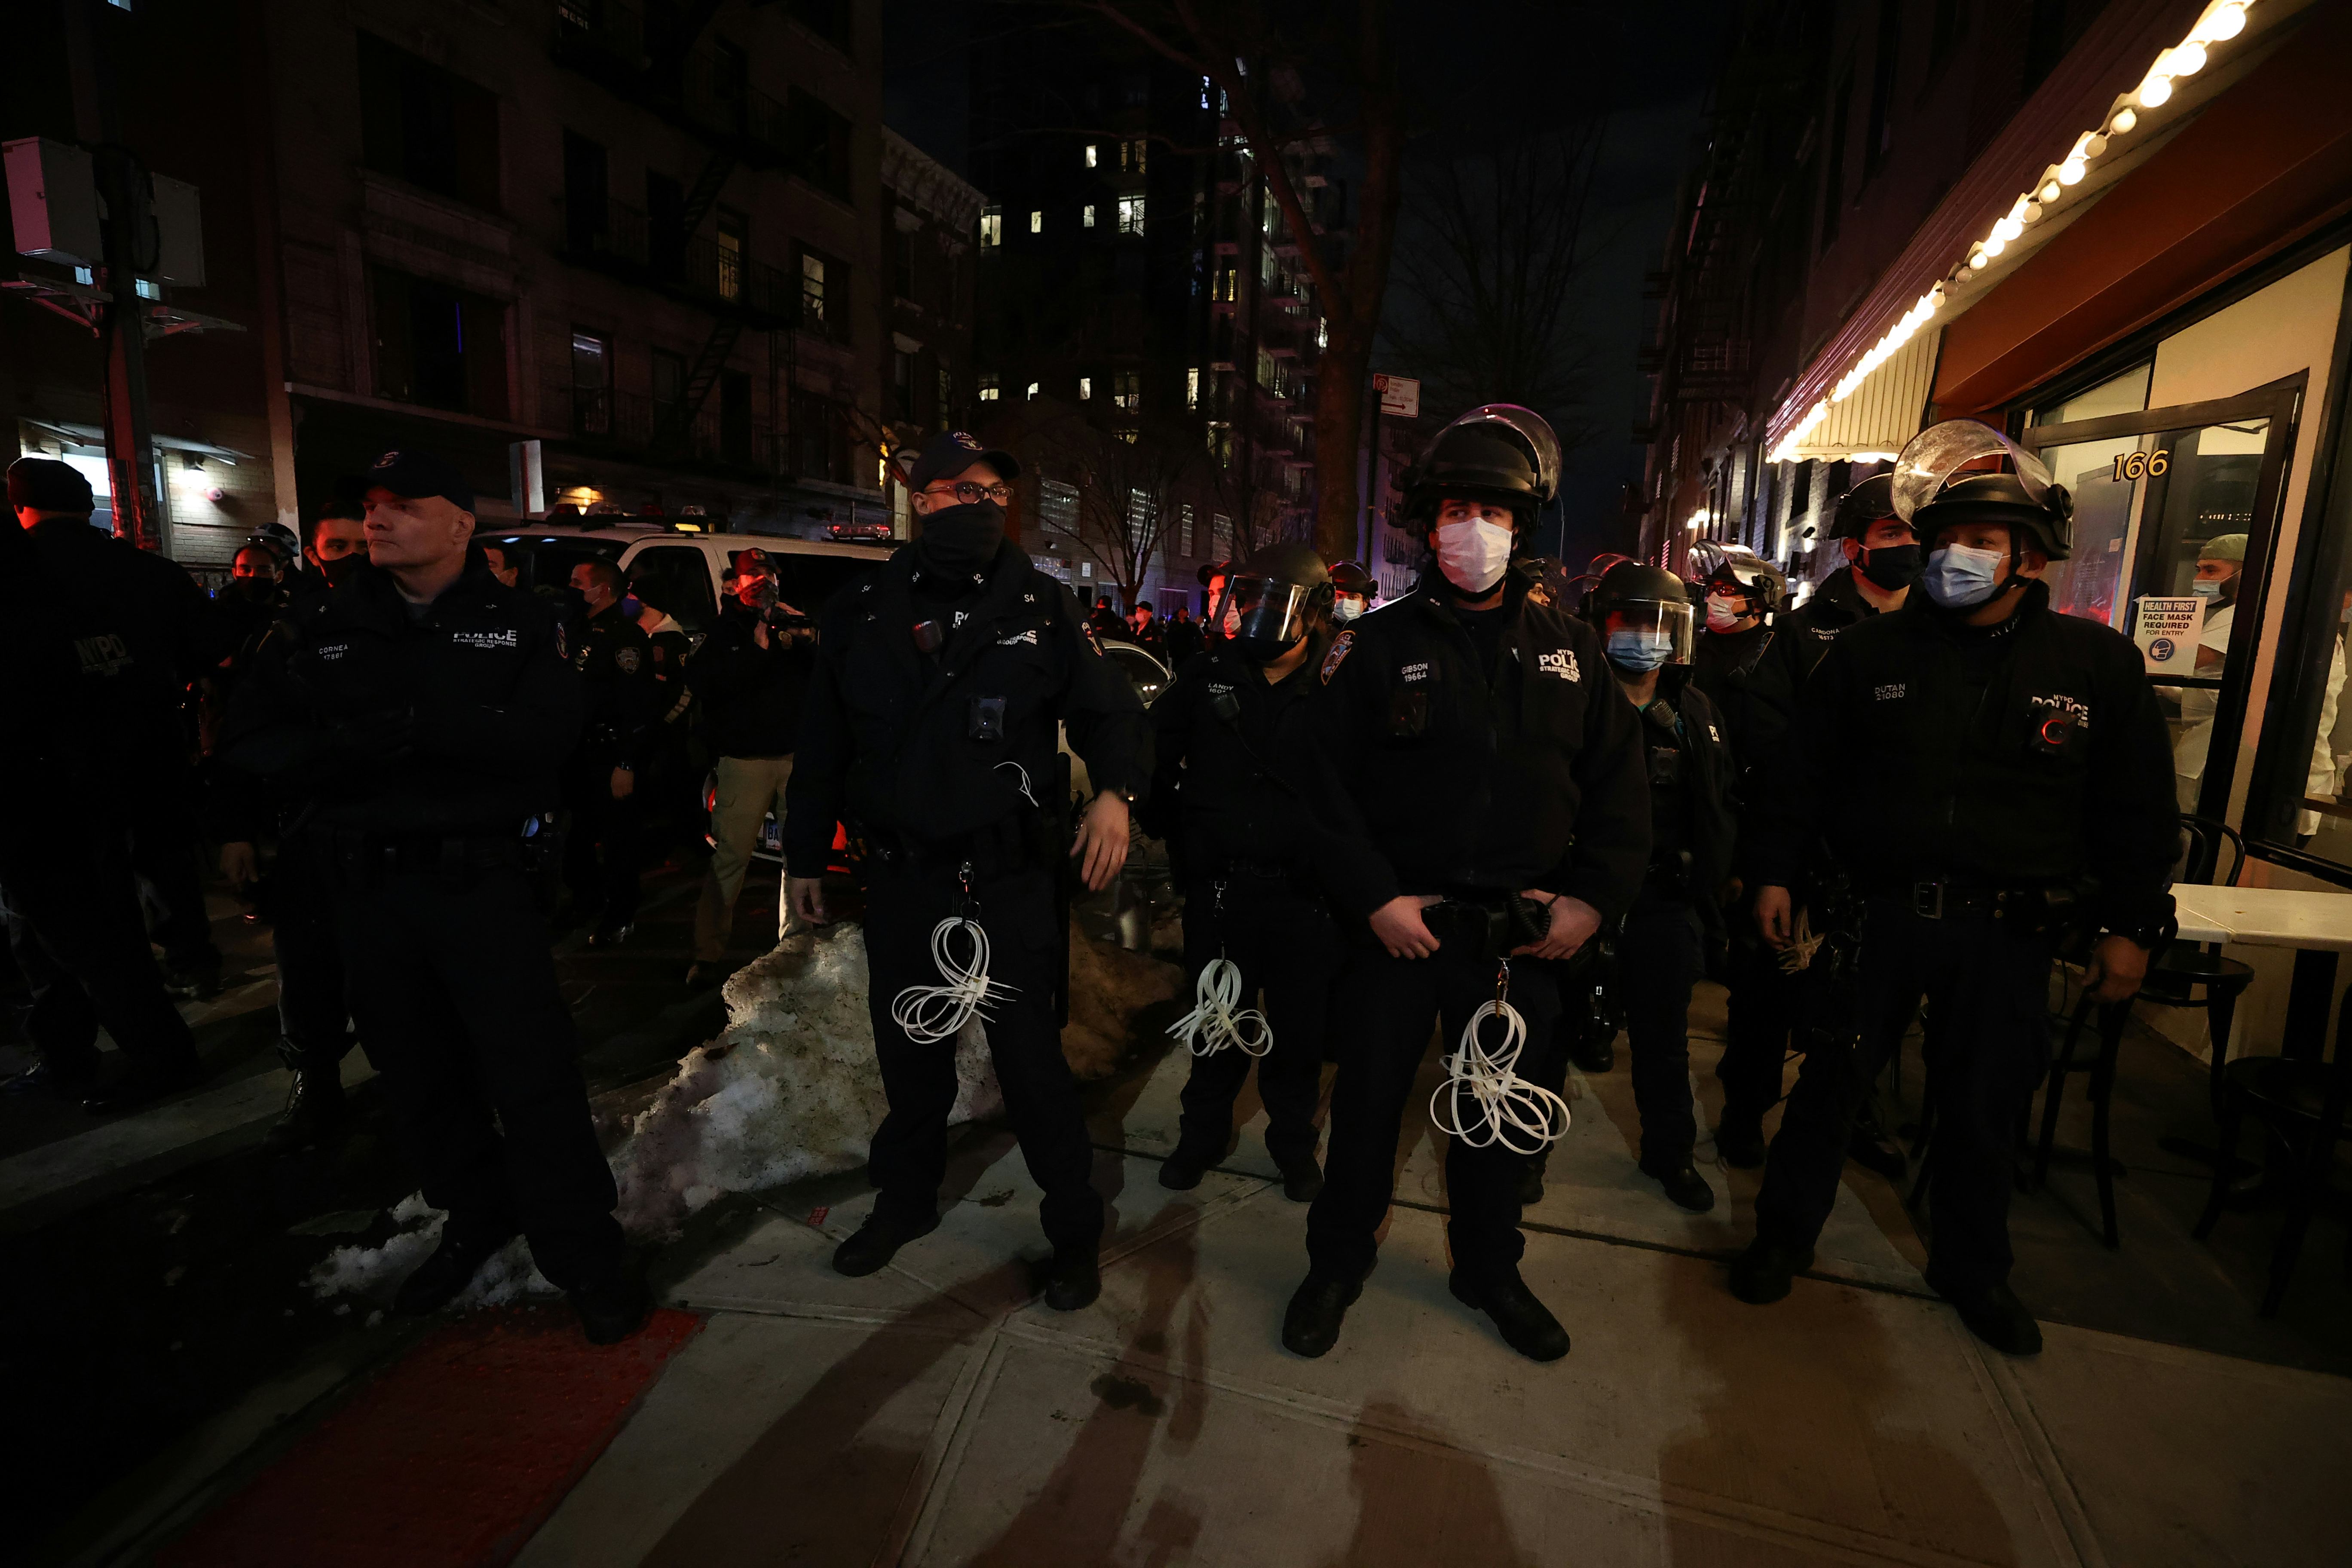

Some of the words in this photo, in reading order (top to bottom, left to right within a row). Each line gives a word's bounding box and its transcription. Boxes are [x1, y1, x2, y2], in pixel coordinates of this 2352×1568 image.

[2112, 448, 2170, 482] 166
[2144, 602, 2172, 611] HEALTH
[2173, 602, 2195, 611] FIRST
[318, 643, 349, 654] CORNEA
[487, 639, 517, 647] RESPONSE
[1402, 662, 1428, 675] GIBSON
[1538, 653, 1580, 673] POLIC
[1404, 671, 1427, 683] 19664
[1208, 683, 1234, 691] LANDY
[1874, 683, 1905, 695] DUTAN
[1875, 690, 1905, 701] 21080
[2053, 694, 2074, 704] NYPD
